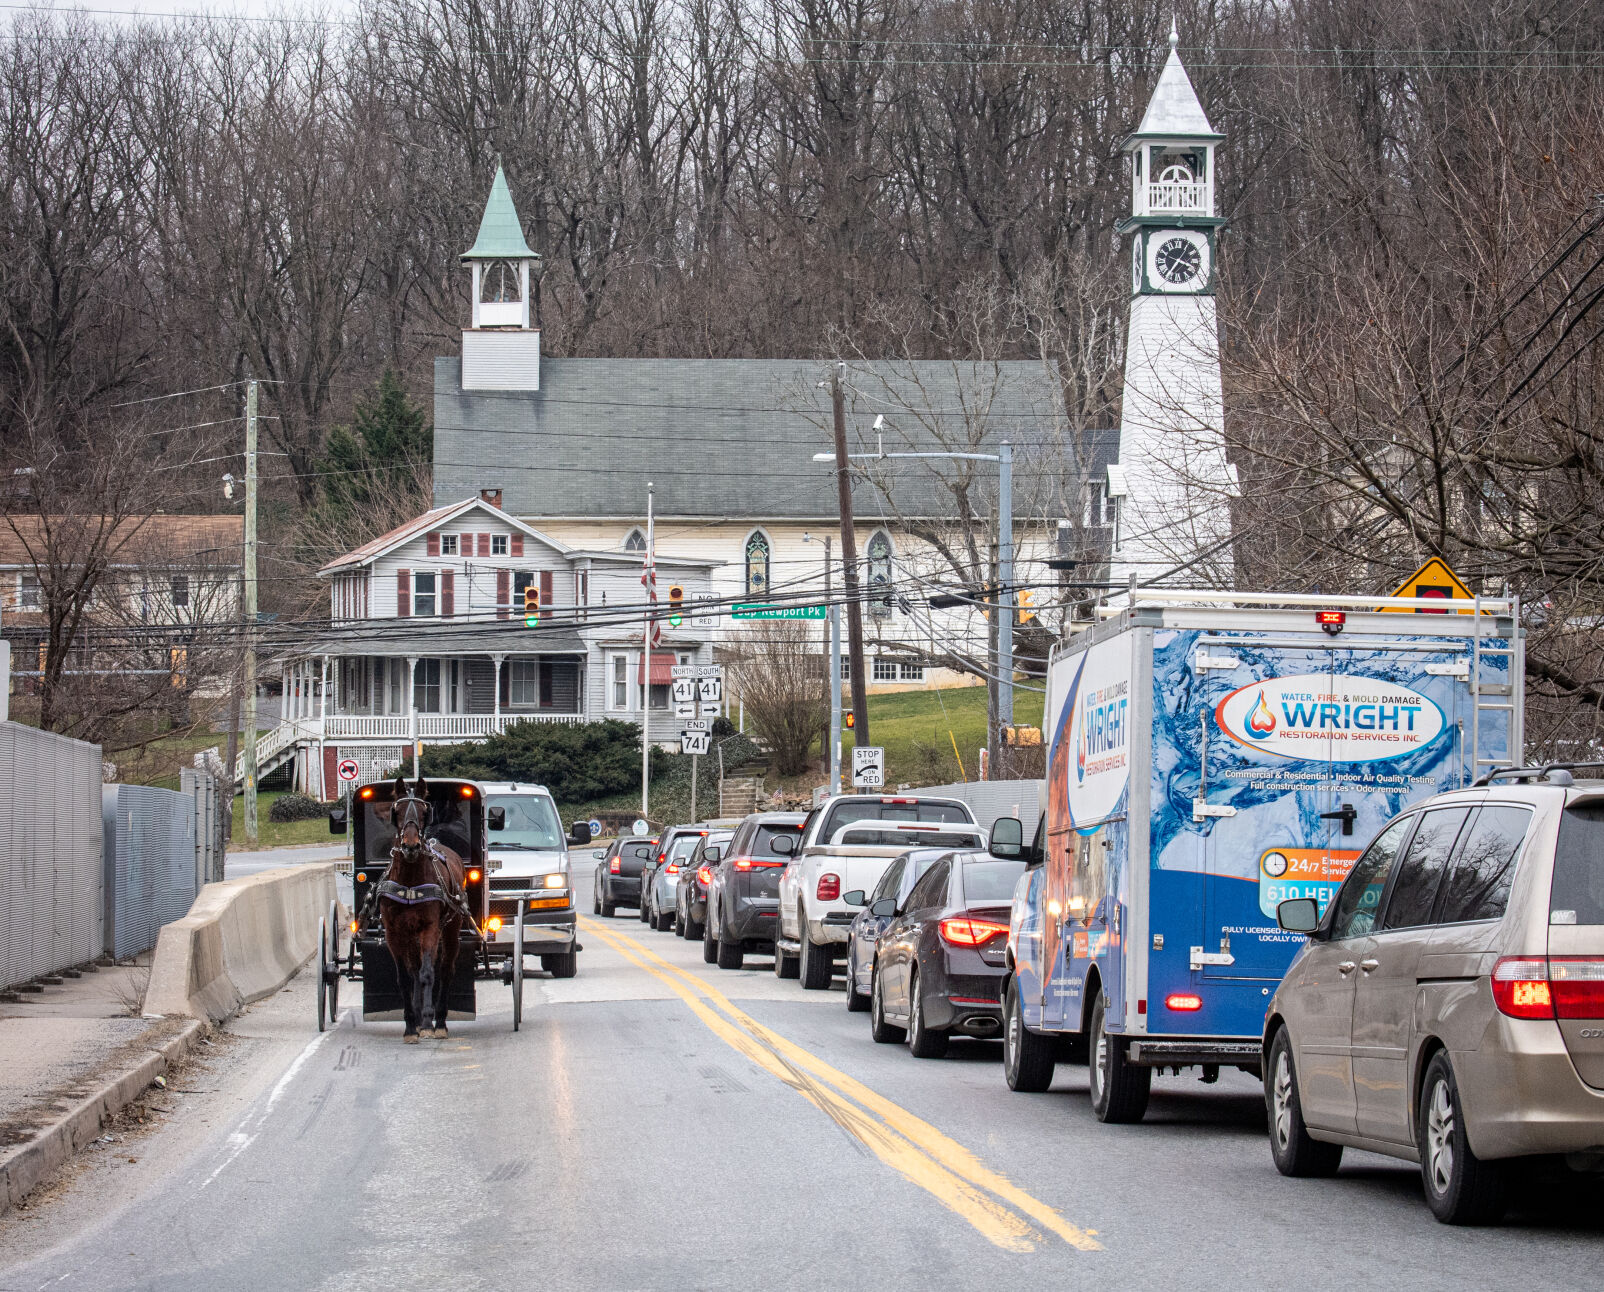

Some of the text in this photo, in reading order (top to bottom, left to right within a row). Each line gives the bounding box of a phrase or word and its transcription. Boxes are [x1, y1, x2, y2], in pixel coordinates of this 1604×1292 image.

[808, 606, 820, 617] Pk
[672, 667, 694, 676] NORTH
[698, 667, 719, 676] SOUTH
[675, 683, 692, 696] 41
[701, 683, 717, 696] 41
[1343, 694, 1350, 703] &
[1352, 694, 1379, 704] MOLD
[1381, 695, 1421, 705] DAMAGE
[1281, 702, 1422, 731] WRIGHT
[687, 721, 705, 729] END
[1086, 698, 1128, 757] WRIGHT
[1279, 730, 1348, 741] RESTORATION
[1351, 732, 1400, 742] SERVICES
[685, 737, 705, 750] 741
[863, 776, 880, 784] RED
[1225, 769, 1435, 785] Commercial & Residential Indoor Air Quality Testing
[1250, 781, 1410, 794] Full construction services Odor removal
[1289, 857, 1320, 873] 24/7
[1267, 886, 1300, 901] 610
[1222, 926, 1245, 934] FULLY
[1245, 927, 1281, 935] LICENSED
